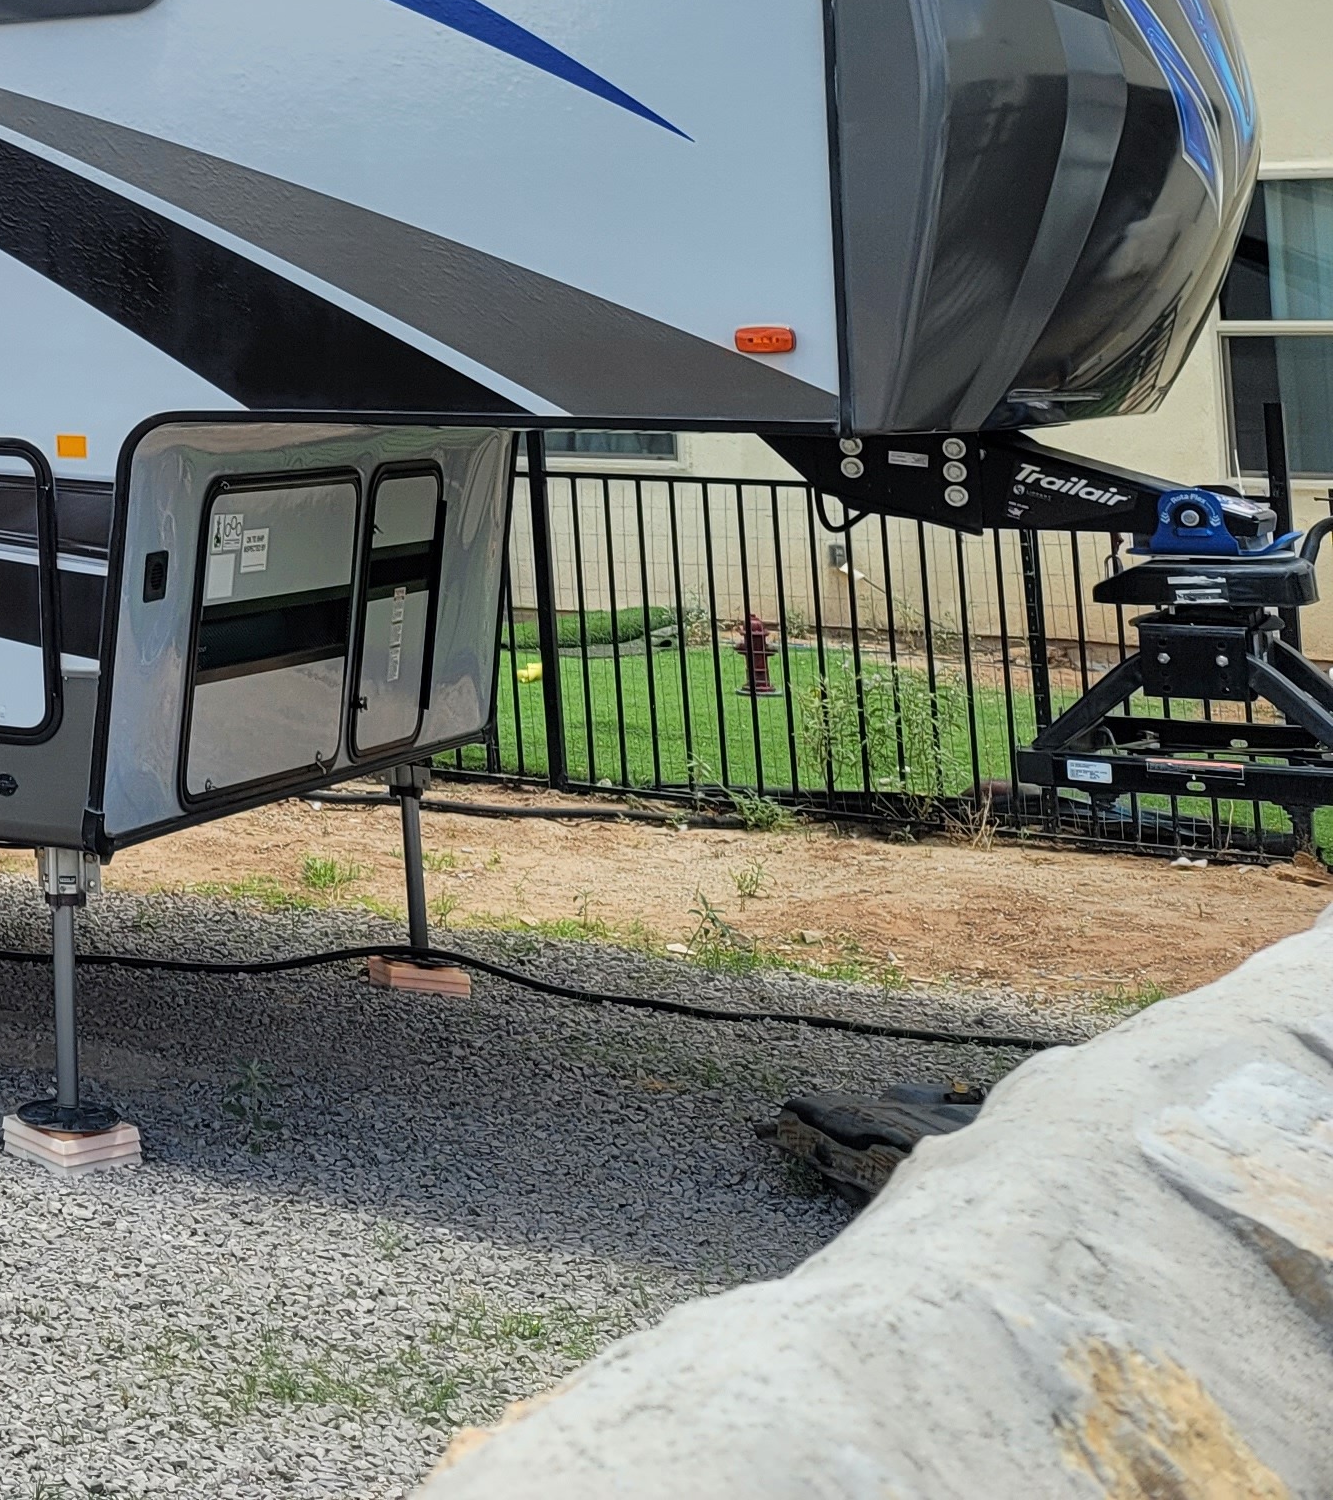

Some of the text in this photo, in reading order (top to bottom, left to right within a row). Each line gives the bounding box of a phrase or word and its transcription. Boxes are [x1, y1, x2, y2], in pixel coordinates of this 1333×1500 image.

[1014, 462, 1129, 506] Trailair
[1170, 493, 1207, 505] Rota Flex
